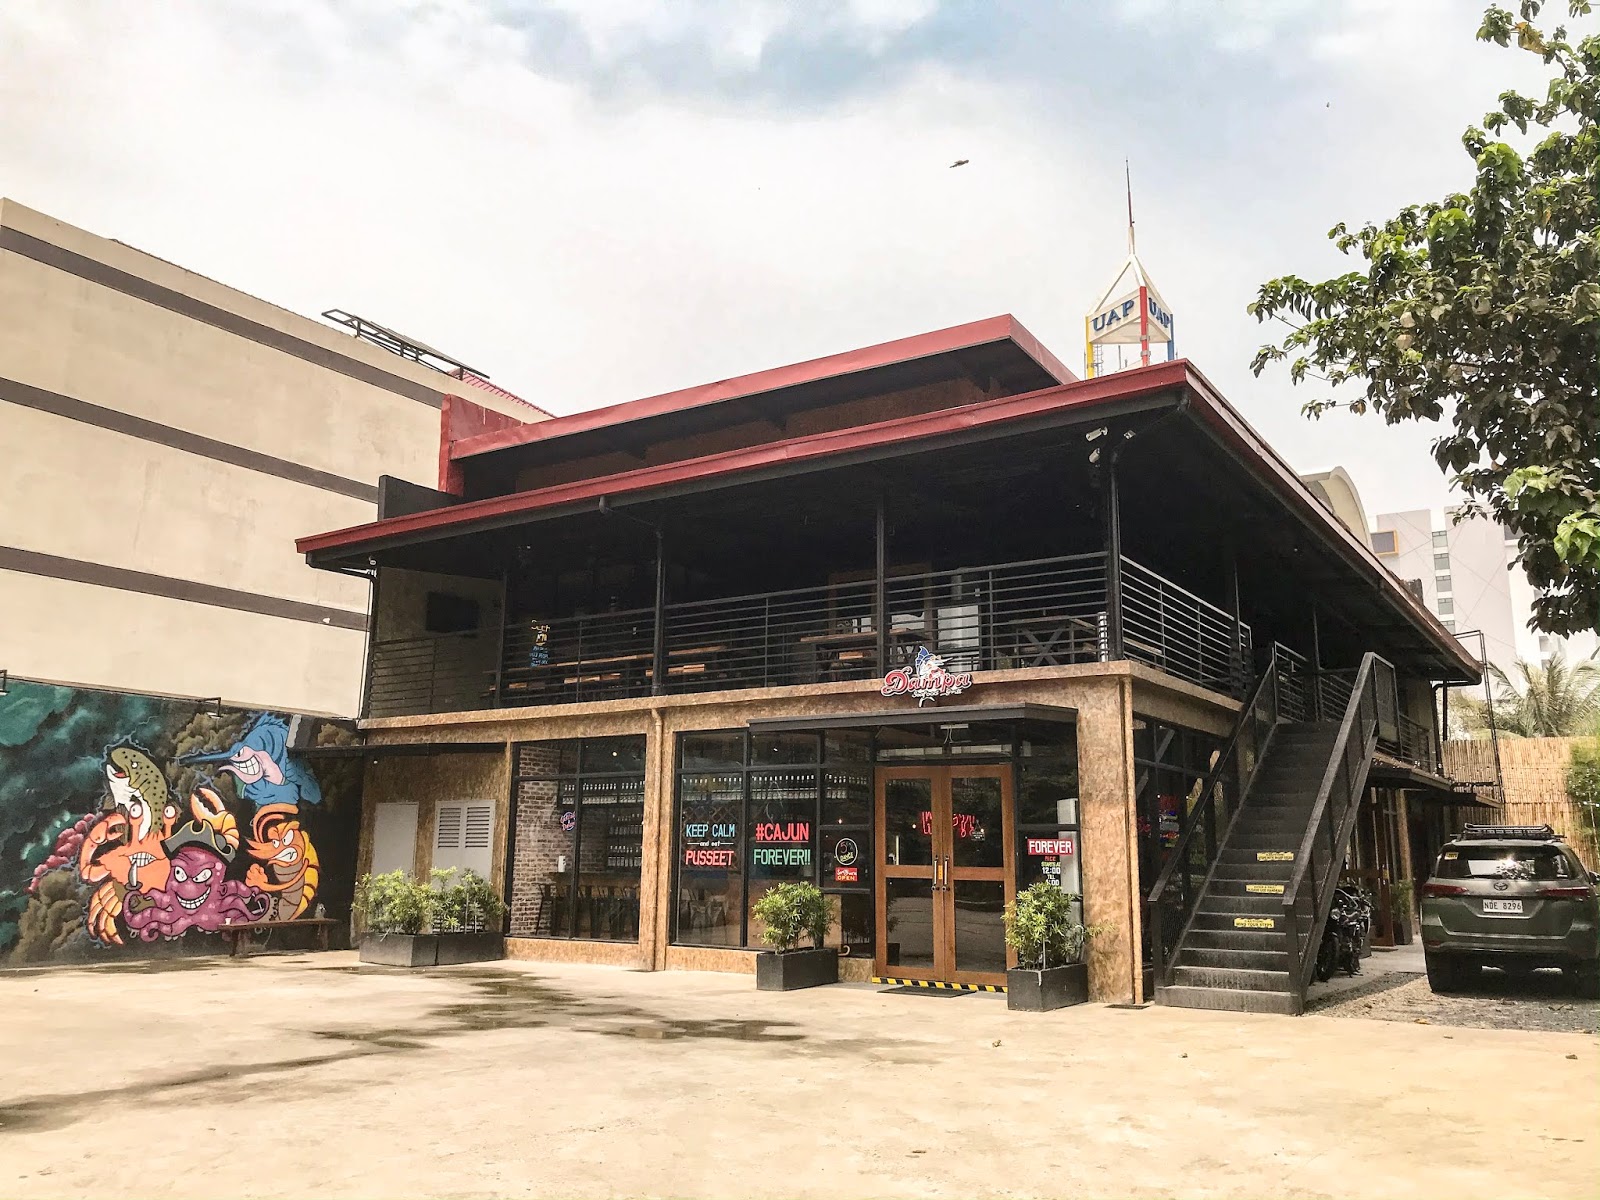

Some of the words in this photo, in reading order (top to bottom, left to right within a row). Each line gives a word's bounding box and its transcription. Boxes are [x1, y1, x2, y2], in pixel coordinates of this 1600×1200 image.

[1092, 300, 1134, 331] UAP
[1148, 297, 1170, 328] UAP
[881, 666, 972, 696] Dampa
[686, 824, 708, 837] KEEP
[712, 824, 735, 837] CALM
[756, 823, 809, 840] #CAJUN
[1029, 841, 1072, 853] FOREVER
[685, 850, 734, 865] PUSSEET
[754, 849, 811, 865] FOREVER!!
[1503, 902, 1521, 910] 8296
